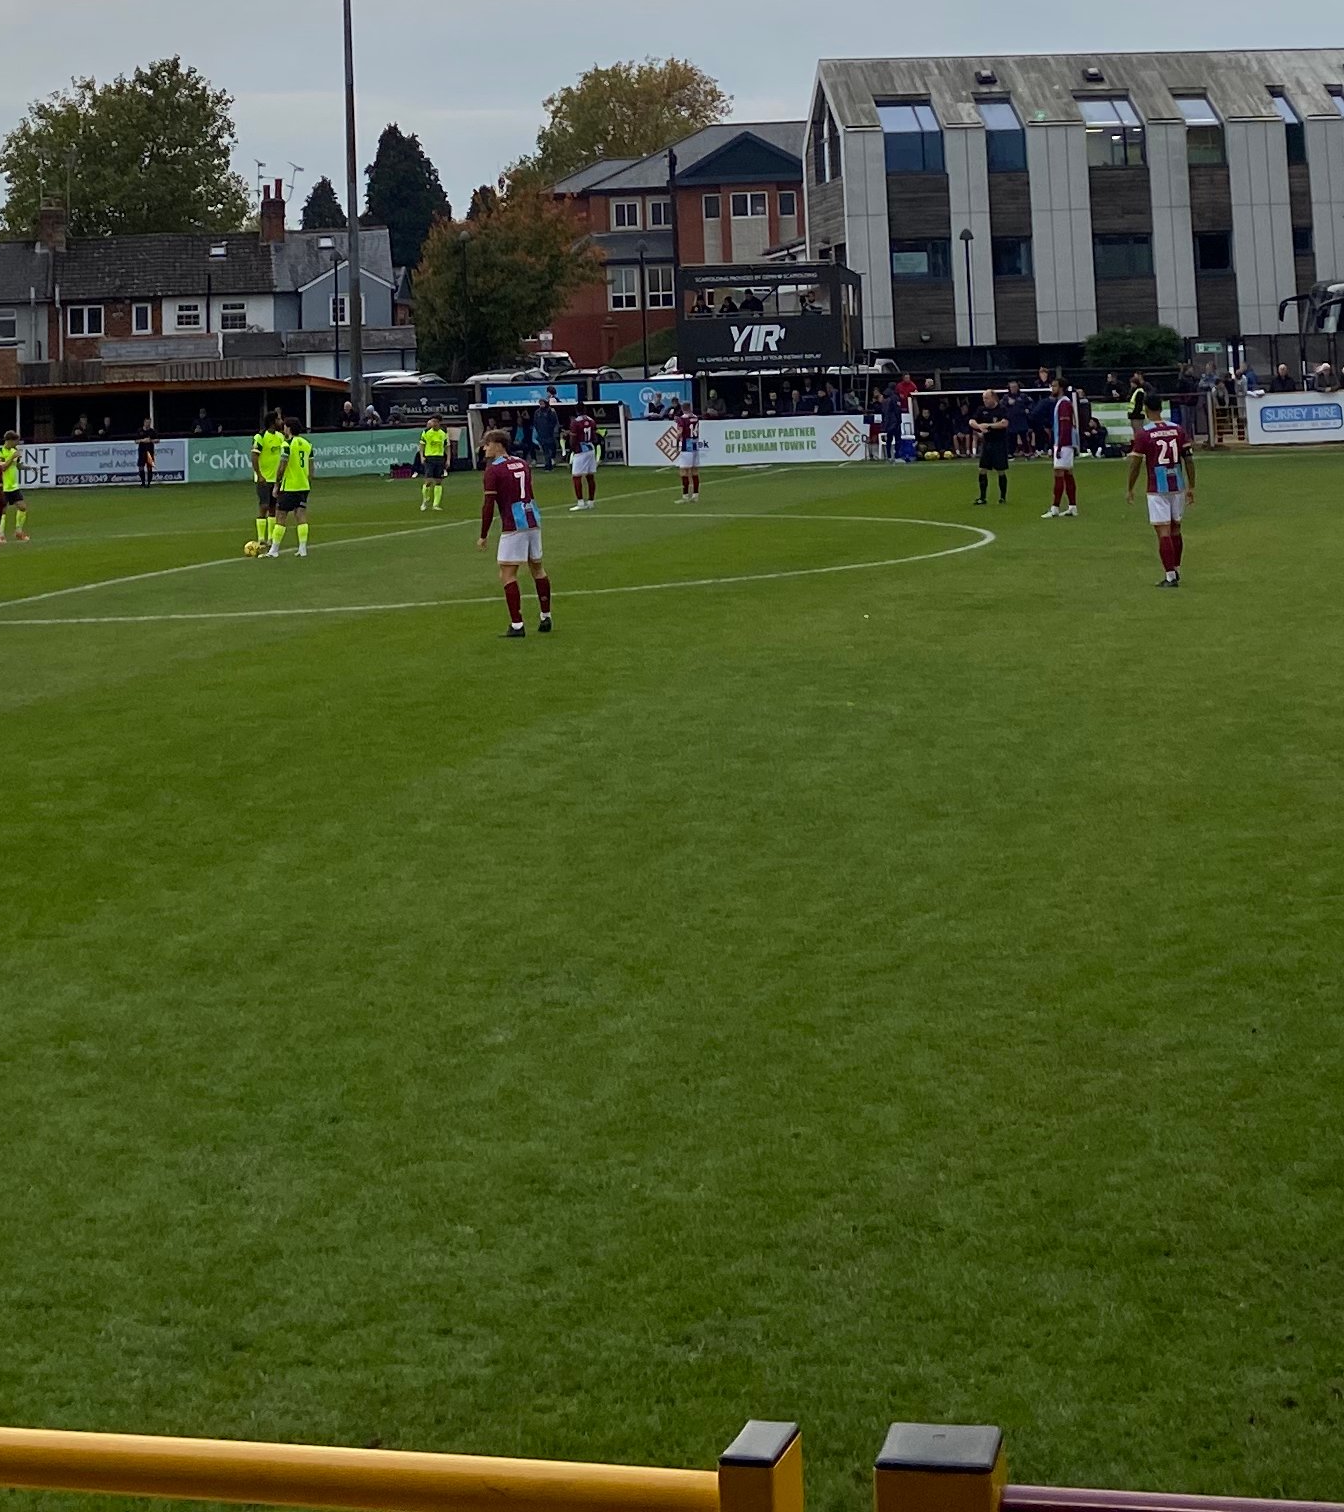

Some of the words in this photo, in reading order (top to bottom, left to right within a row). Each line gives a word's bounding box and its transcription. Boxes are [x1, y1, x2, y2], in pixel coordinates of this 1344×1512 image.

[1265, 408, 1308, 421] SURREY
[1312, 406, 1338, 419] HIRE
[725, 430, 740, 440] LCD
[742, 429, 777, 439] DISPLAY
[778, 427, 816, 438] PARTNER
[65, 448, 111, 458] Commercial
[312, 445, 376, 457] OMPRESSION
[725, 443, 735, 453] OF
[737, 442, 778, 453] FARNHAM
[780, 441, 805, 451] TOWN
[807, 440, 817, 450] FC
[1156, 438, 1179, 465] 21
[513, 470, 526, 499] 7
